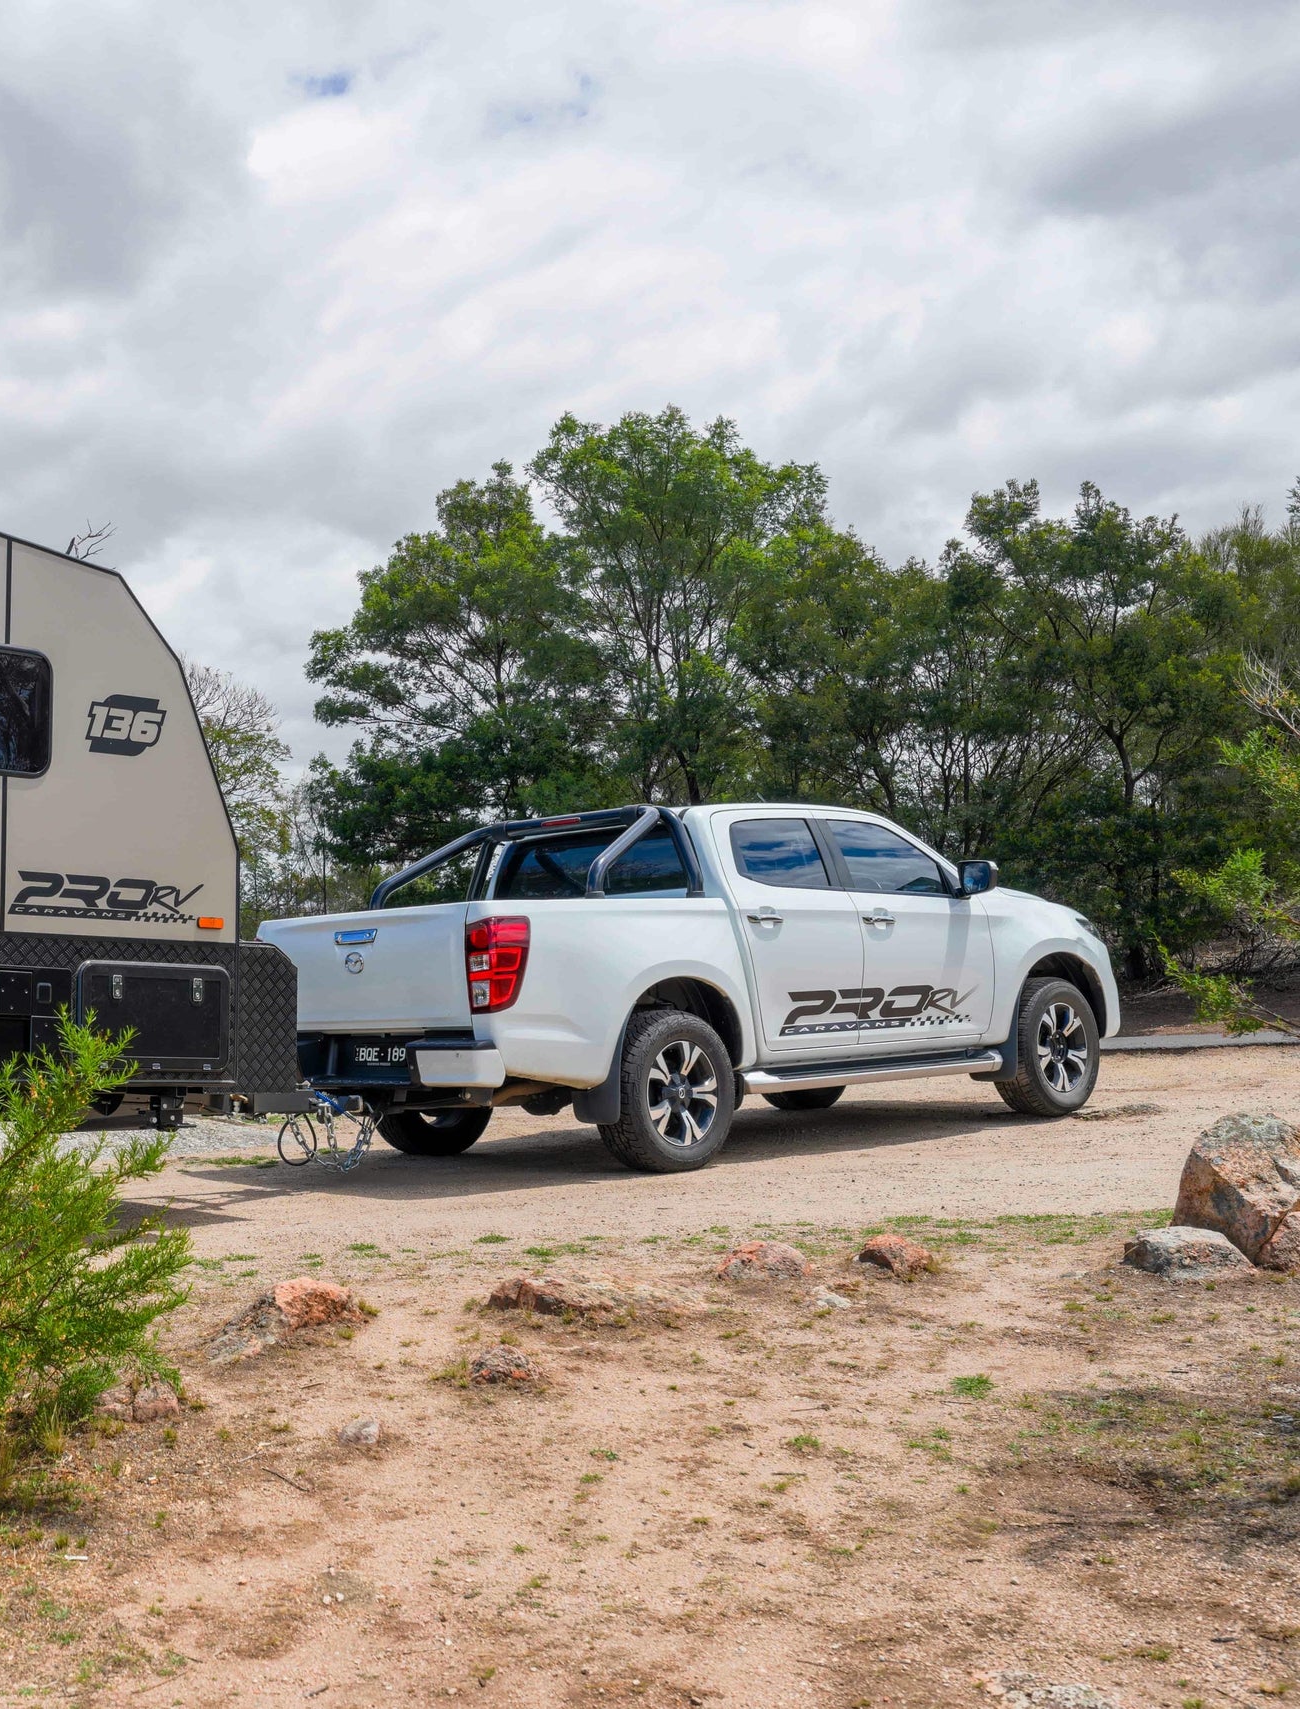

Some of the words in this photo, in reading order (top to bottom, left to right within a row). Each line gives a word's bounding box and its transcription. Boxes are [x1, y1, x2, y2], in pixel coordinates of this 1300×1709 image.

[87, 703, 165, 745] 136
[13, 870, 158, 911] PRO
[148, 883, 204, 915] RV
[15, 905, 127, 919] CARAVANS
[783, 984, 935, 1026] PRO
[923, 984, 979, 1015] RV
[784, 1020, 900, 1035] CARAVANS
